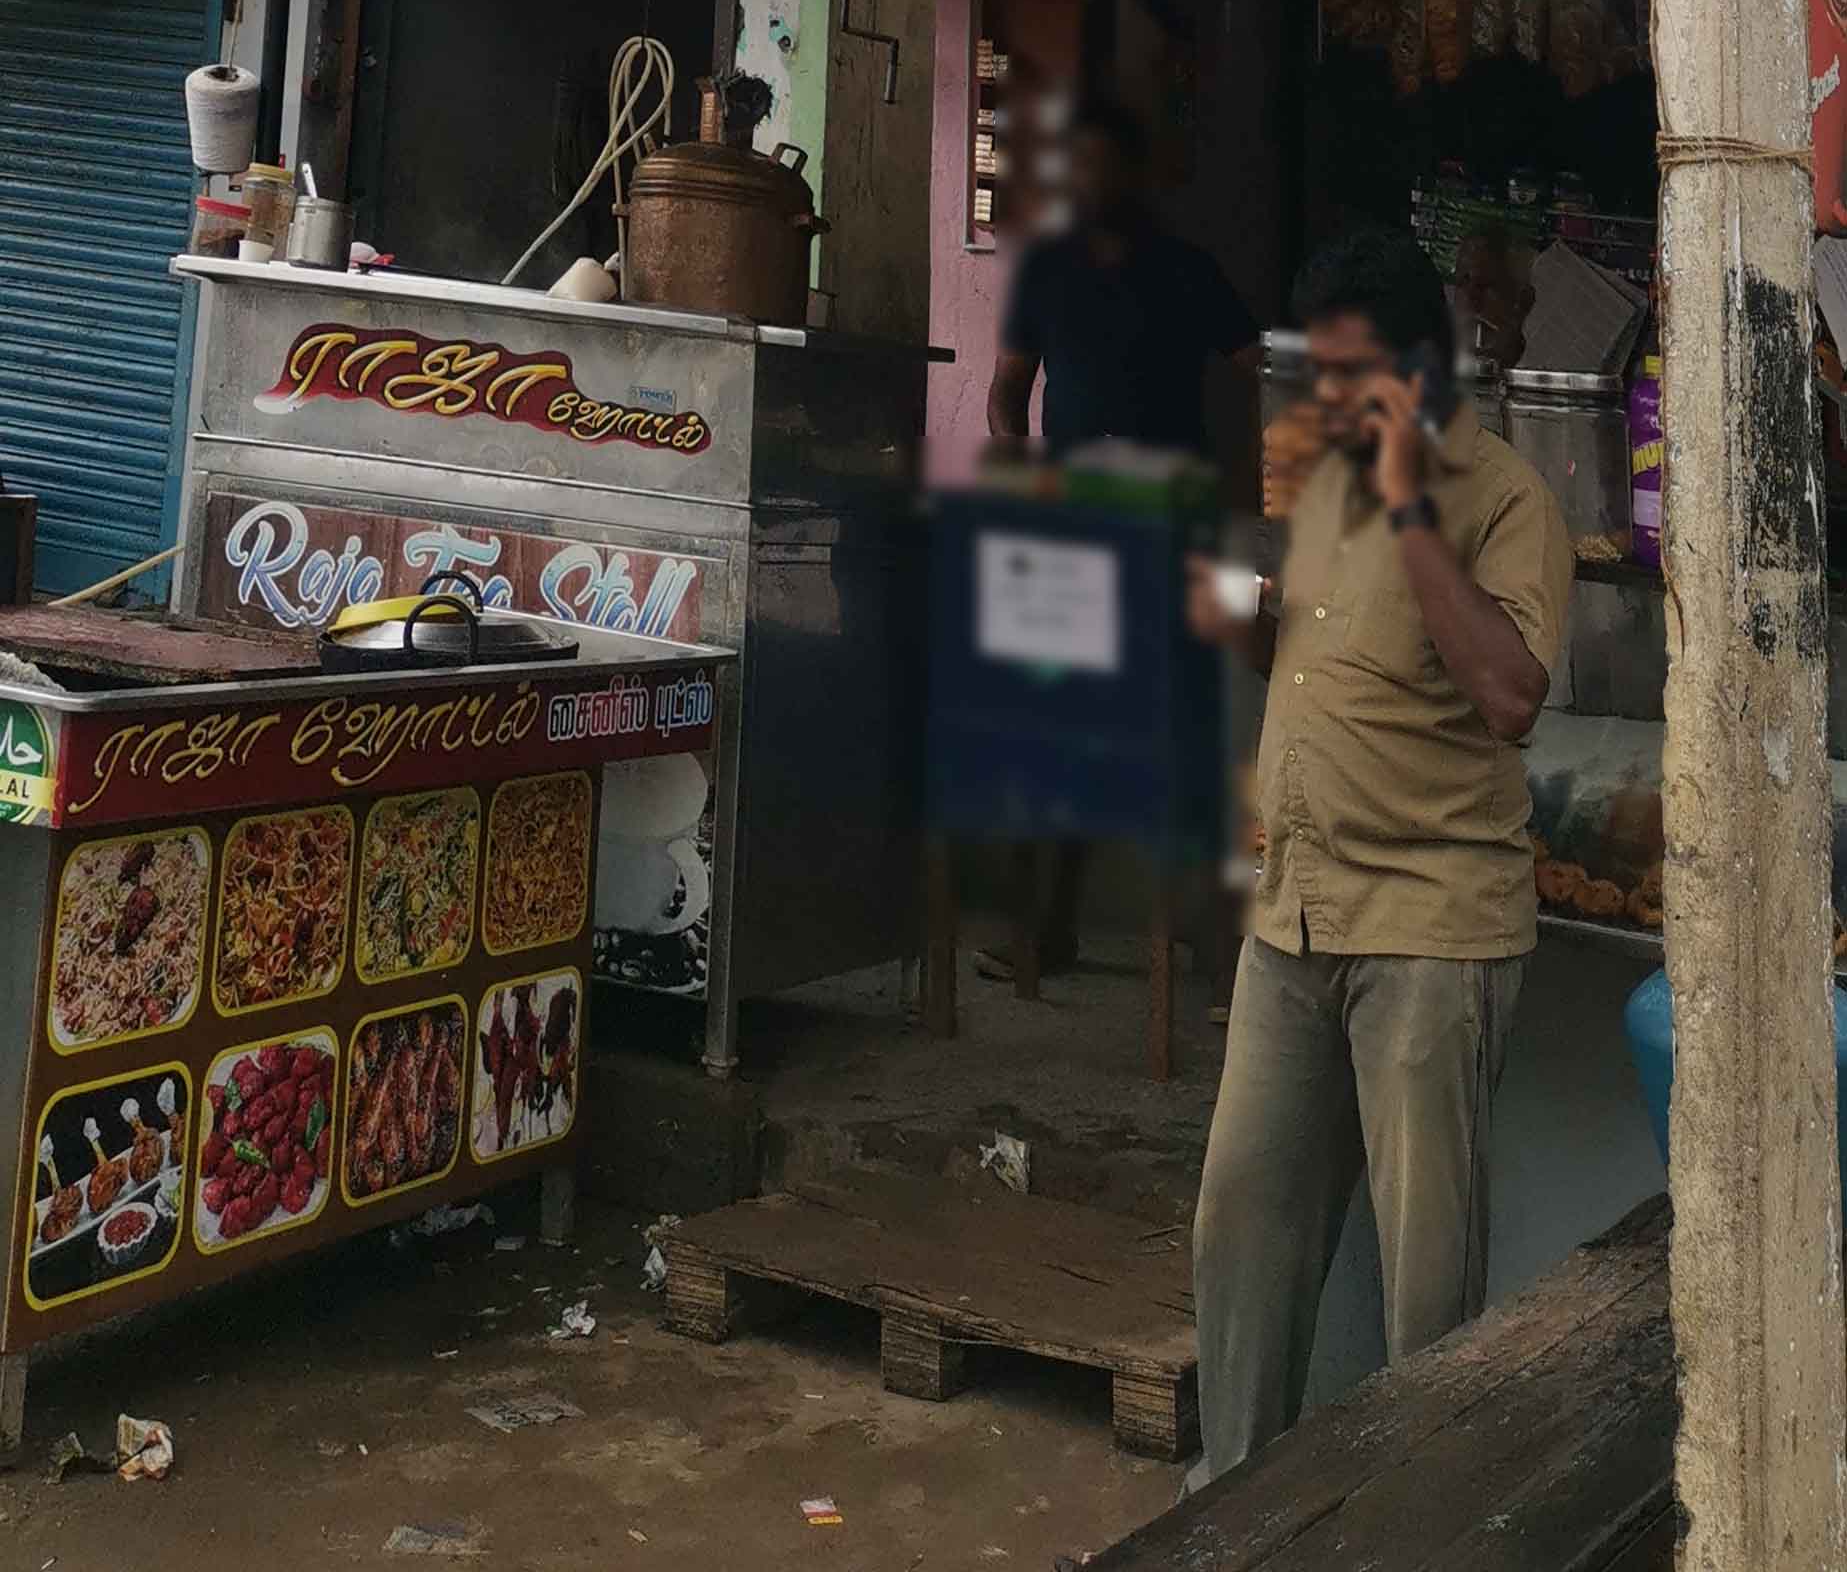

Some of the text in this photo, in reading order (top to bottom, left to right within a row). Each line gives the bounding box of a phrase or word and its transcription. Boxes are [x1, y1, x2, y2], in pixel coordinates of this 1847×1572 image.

[288, 332, 706, 449] ராஜா ஹோட்டல்
[224, 501, 384, 628] Raja
[539, 544, 698, 638] Stall
[68, 712, 281, 815] ராஜா
[290, 681, 541, 787] ஹோட்டல்
